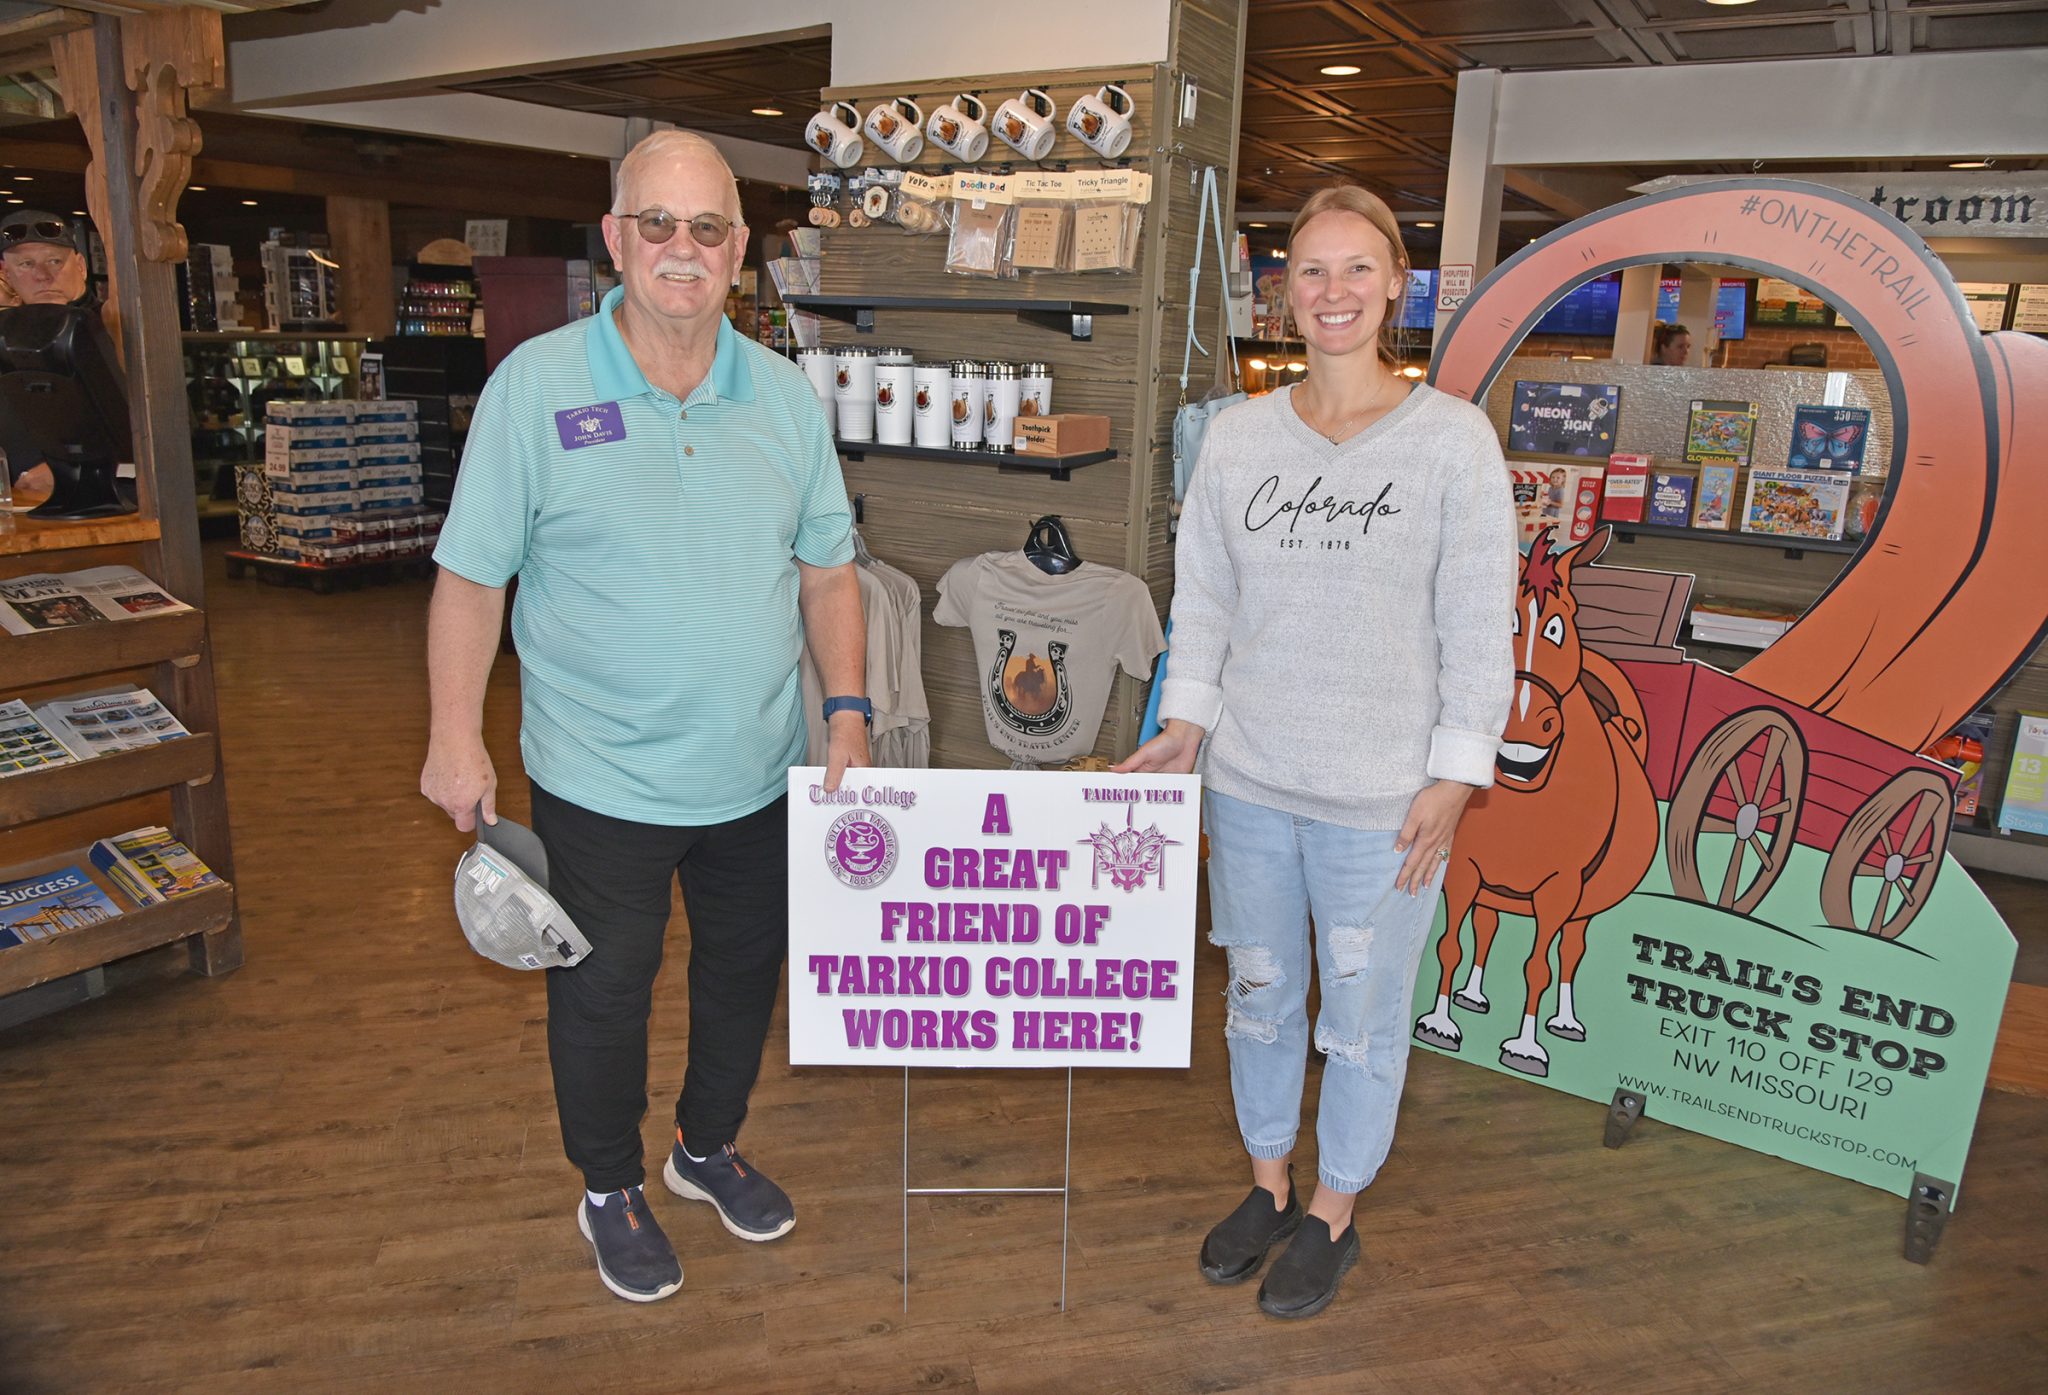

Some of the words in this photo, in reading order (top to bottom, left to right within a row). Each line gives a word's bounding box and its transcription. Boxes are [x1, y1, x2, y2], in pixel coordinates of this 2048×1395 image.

[907, 175, 928, 189] YoYo
[960, 179, 987, 190] Doodle
[989, 182, 1006, 192] Pad
[1026, 179, 1035, 187] Tic
[1037, 179, 1049, 188] Tac
[1050, 180, 1063, 188] Toe
[1077, 179, 1098, 188] Tricky
[1100, 176, 1129, 186] Triangle
[1869, 186, 2037, 225] troom
[1741, 195, 1930, 320] #ONTHETRAIL
[1443, 269, 1470, 278] SHOPLIFTERS
[1445, 279, 1457, 287] WILL
[1459, 279, 1466, 287] BE
[1441, 288, 1468, 296] PROSECUTED
[566, 407, 590, 420] TARKIO
[591, 406, 608, 414] TECH
[1534, 406, 1572, 419] NEON
[1834, 410, 1852, 421] 350
[1022, 424, 1051, 433] Toothpick
[1563, 419, 1594, 431] SIGN
[574, 433, 592, 442] JOHN
[593, 430, 613, 439] DAVIS
[1026, 435, 1046, 443] Holder
[269, 462, 286, 472] 24.99
[1777, 472, 1802, 480] FLOOR
[1803, 474, 1833, 482] PUZZLE
[1244, 475, 1401, 535] Colorado
[1280, 539, 1309, 549] EST.
[1320, 540, 1350, 550] 1876
[1018, 738, 1053, 750] TRAVEL
[1053, 719, 1081, 746] CENTER
[2018, 758, 2041, 774] 13
[808, 783, 858, 806] Tarkio
[861, 785, 917, 809] College
[1082, 787, 1140, 802] TARKIO
[1144, 788, 1184, 803] TECH
[981, 793, 1012, 834] A
[2005, 813, 2044, 830] Stove
[924, 847, 1069, 890] GREAT
[848, 875, 873, 885] 1883
[0, 874, 80, 905] SUCCESS
[881, 901, 1041, 944] FRIEND
[1055, 904, 1110, 945] OF
[809, 955, 971, 996] TARKIO
[985, 957, 1178, 1000] COLLEGE
[1632, 933, 1822, 1005] TRAIL'S
[1841, 985, 1956, 1037] END
[843, 1009, 998, 1049] WORKS
[1013, 1011, 1143, 1052] HERE!
[1627, 973, 1792, 1042] TRUCK
[1808, 1022, 1947, 1079] STOP
[1659, 1018, 1716, 1048] EXIT
[1727, 1036, 1766, 1063] 110
[1779, 1051, 1835, 1080] OFF
[1673, 1051, 1719, 1078] NW
[1730, 1065, 1868, 1121] MISSOURI
[1617, 1073, 1918, 1171] WWW.TRAILSENDTRUCKSTOP.COM
